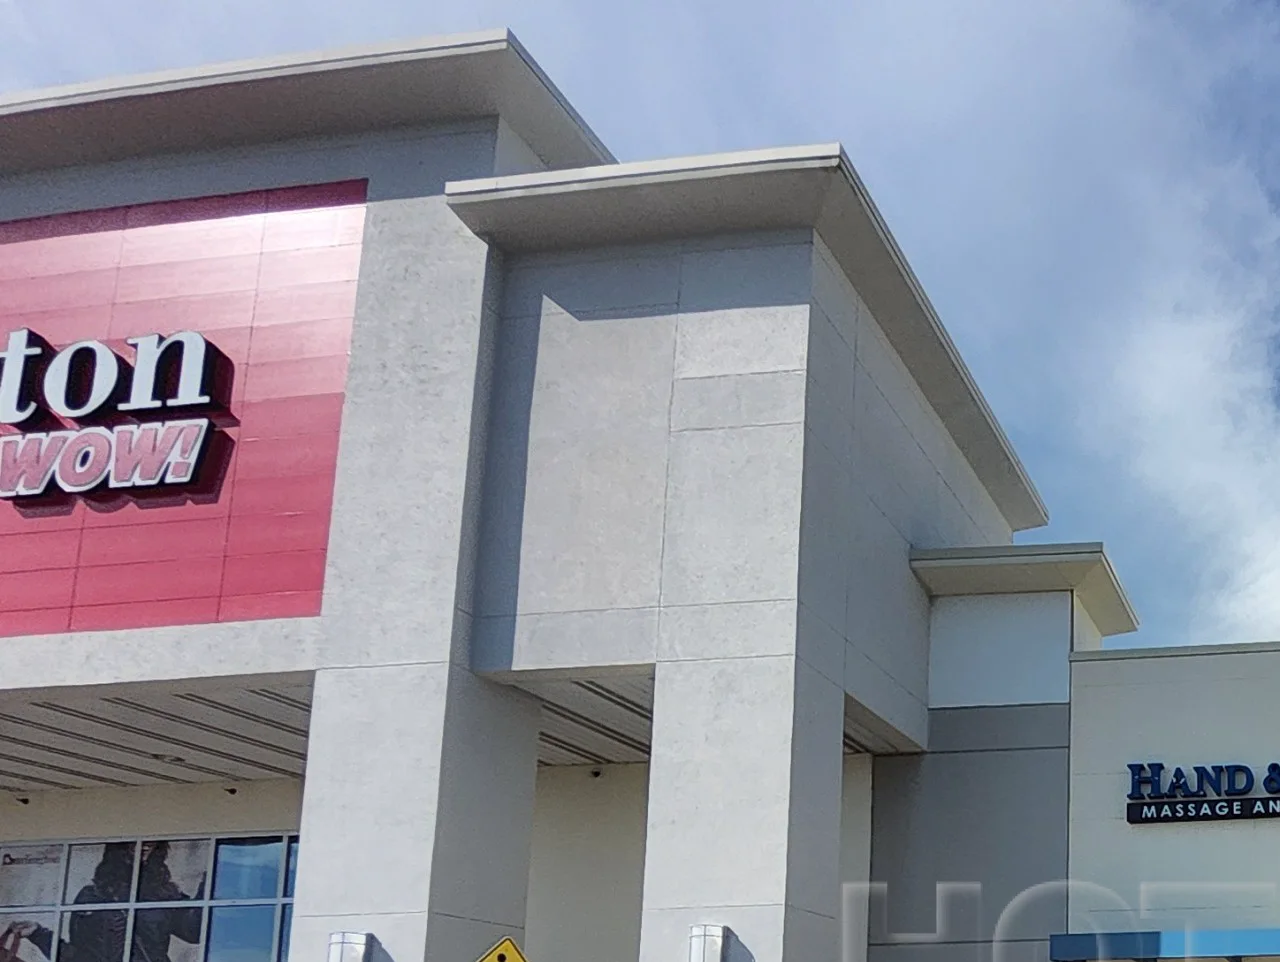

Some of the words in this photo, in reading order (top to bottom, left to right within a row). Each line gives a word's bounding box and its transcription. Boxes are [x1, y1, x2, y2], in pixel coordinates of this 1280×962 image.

[0, 327, 211, 424] ton
[0, 418, 209, 498] WOW!
[1126, 763, 1255, 800] HAND
[1141, 801, 1242, 819] MASSAGE
